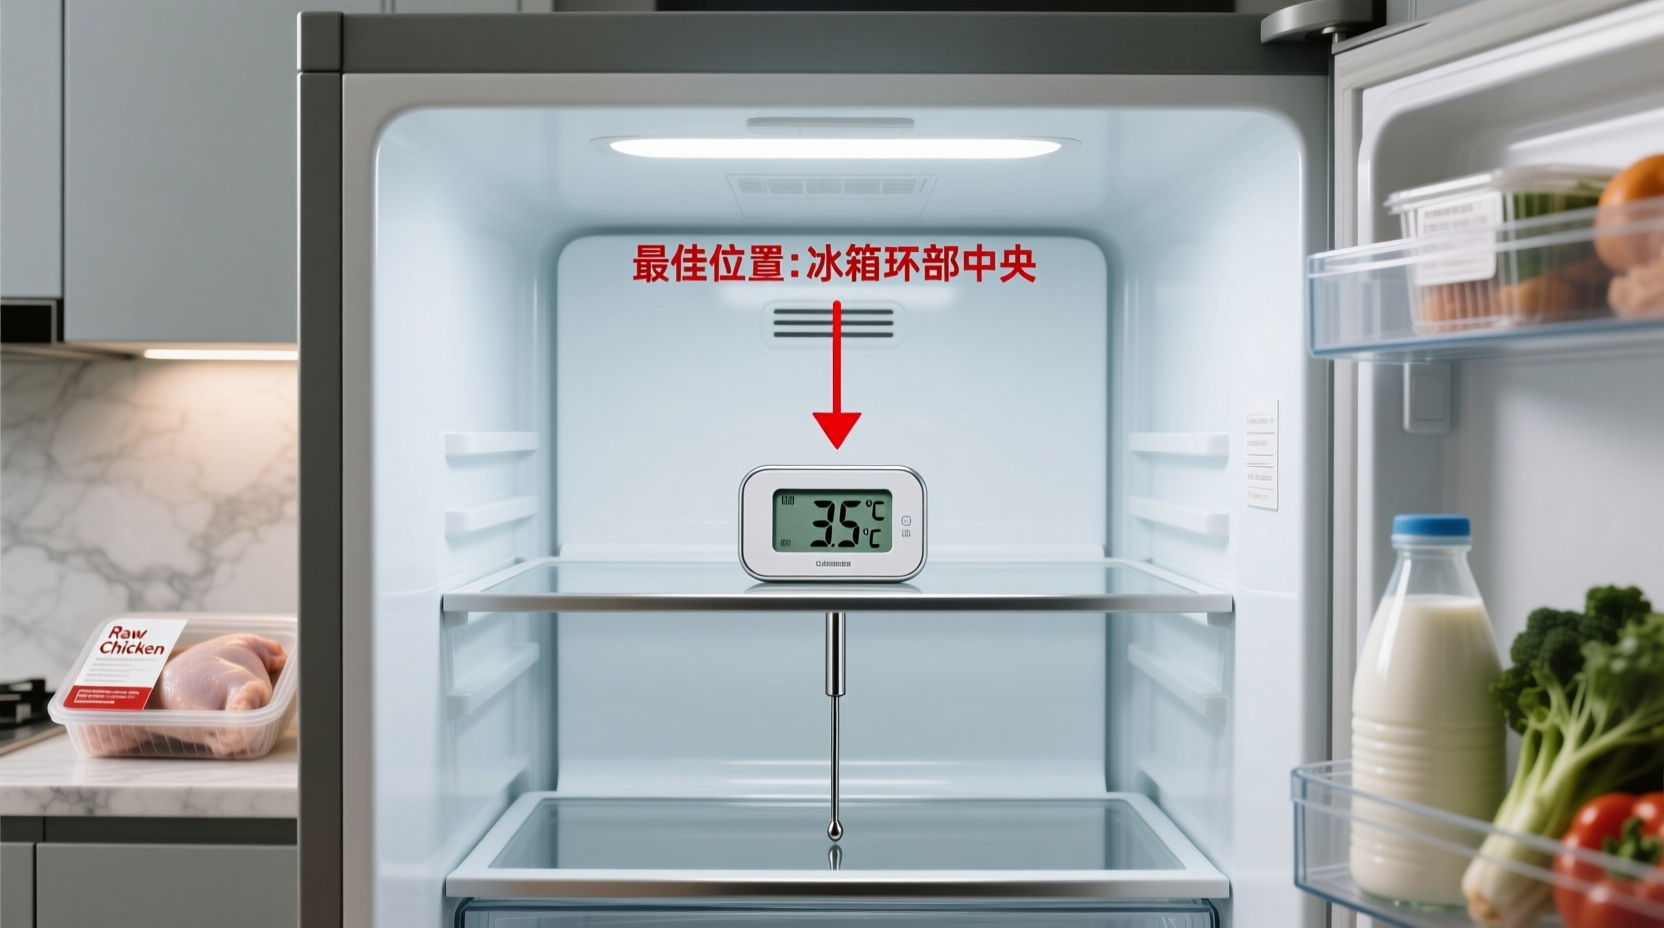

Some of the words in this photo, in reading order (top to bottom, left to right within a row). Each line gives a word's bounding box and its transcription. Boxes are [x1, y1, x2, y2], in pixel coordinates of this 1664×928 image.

[809, 500, 861, 548] 3.5
[108, 625, 148, 640] Raw
[99, 640, 165, 655] Chicken
